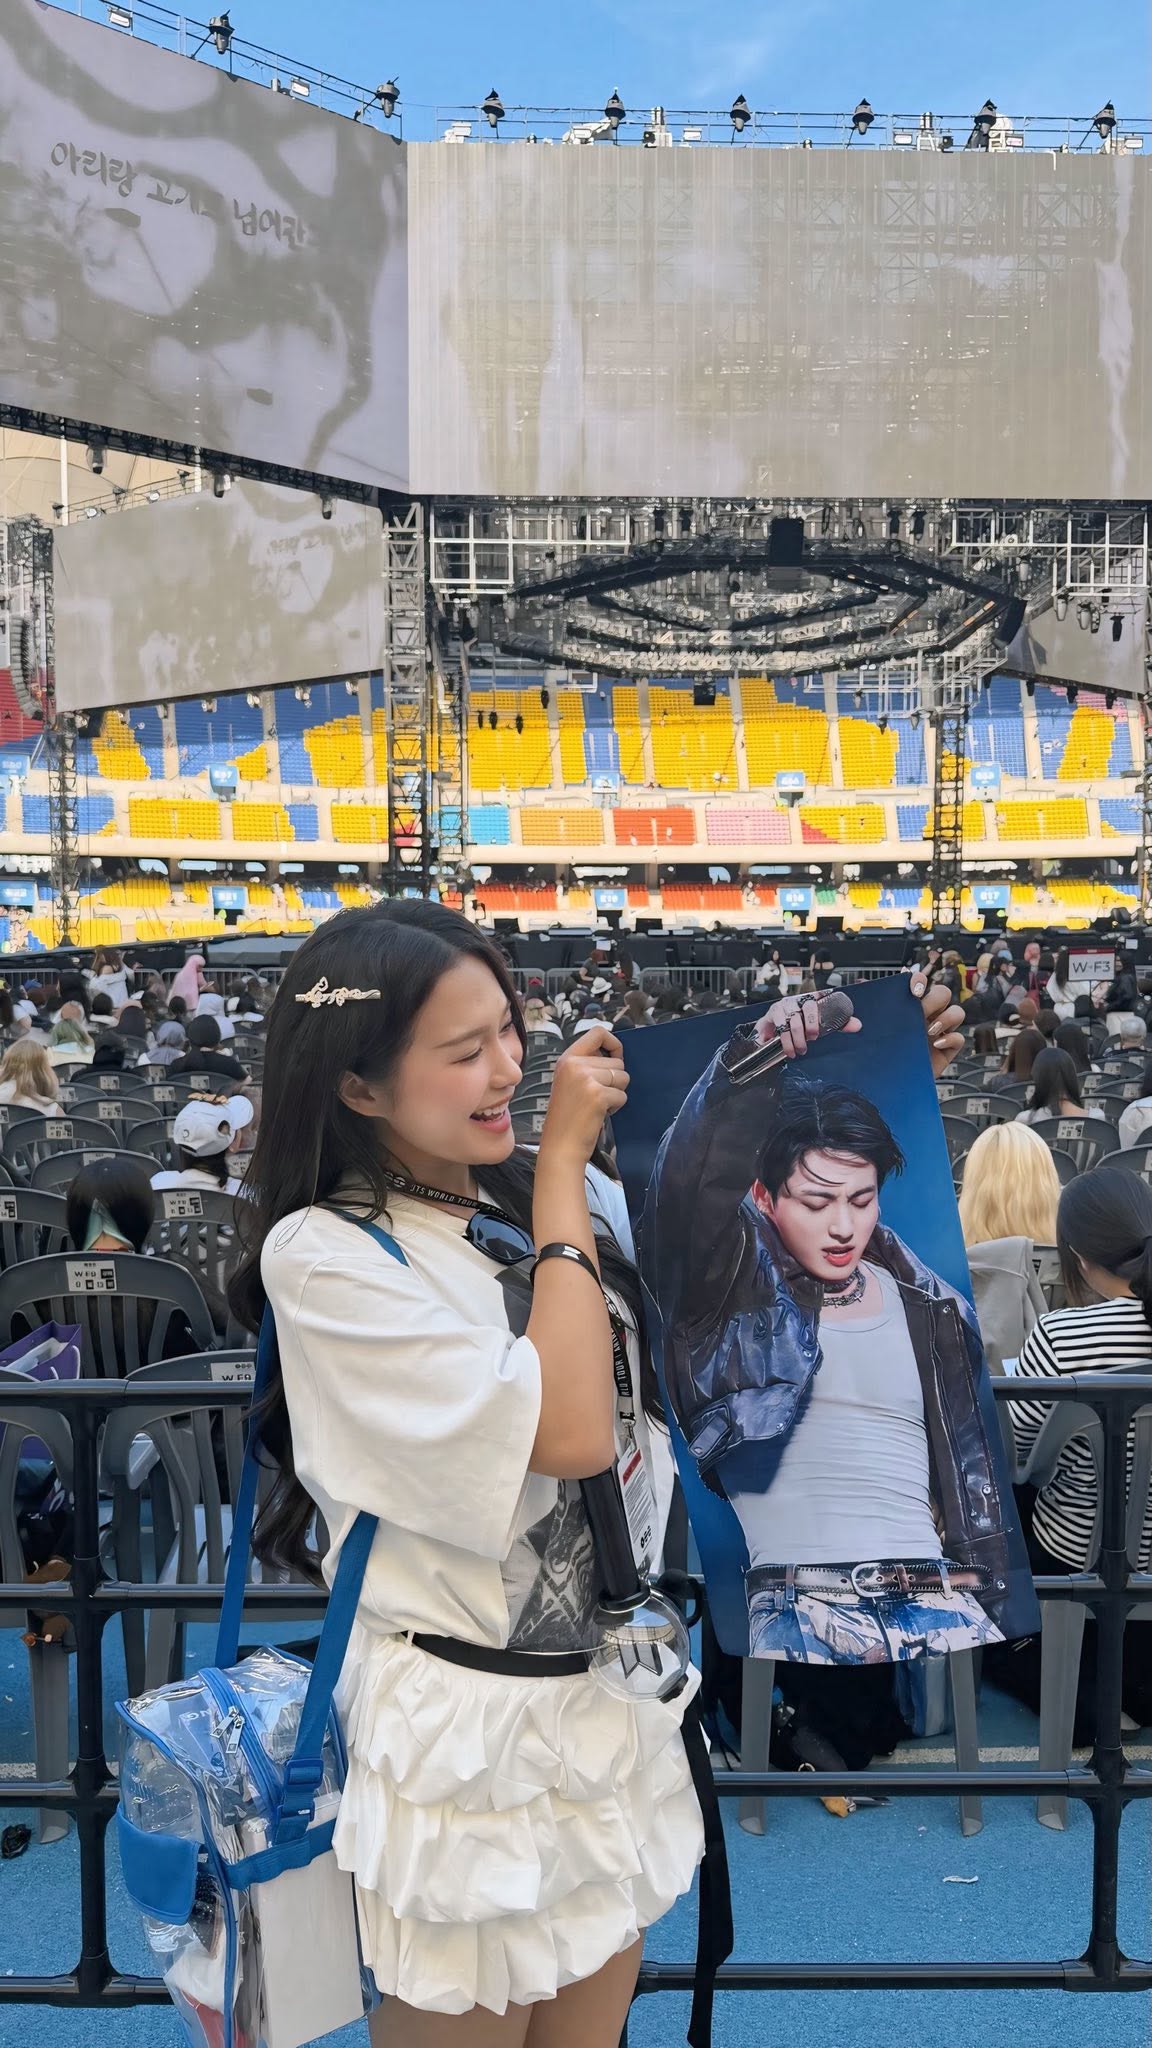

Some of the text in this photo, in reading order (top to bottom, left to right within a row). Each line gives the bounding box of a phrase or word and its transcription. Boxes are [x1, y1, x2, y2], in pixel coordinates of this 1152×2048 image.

[51, 142, 137, 197] 아리랑
[1072, 961, 1111, 973] W-F3
[427, 1189, 456, 1203] WORLD
